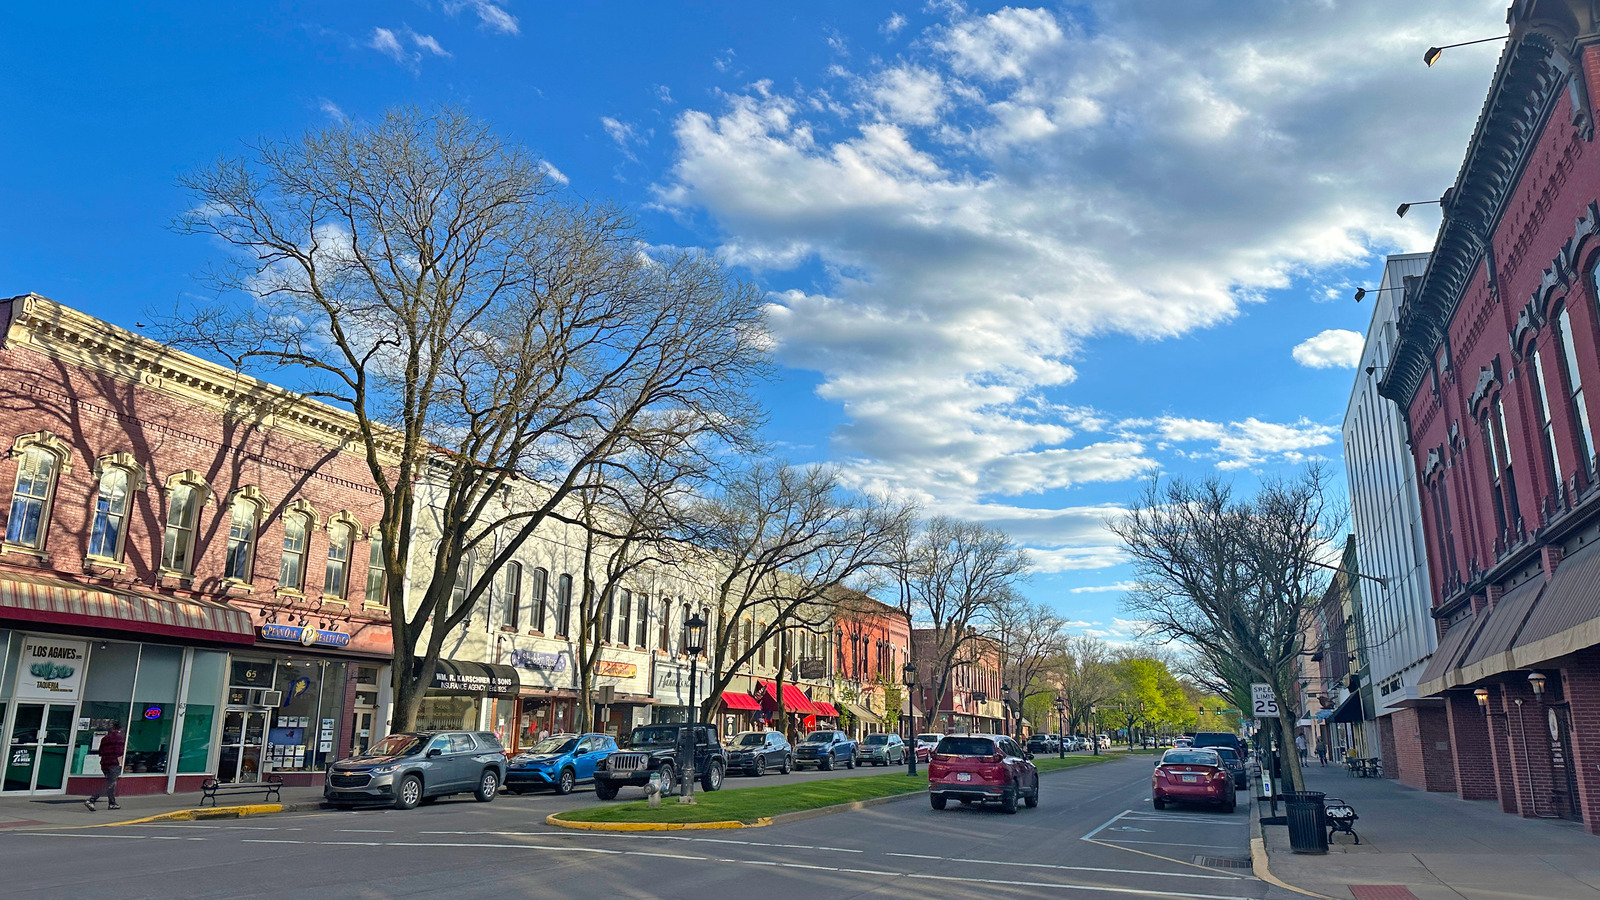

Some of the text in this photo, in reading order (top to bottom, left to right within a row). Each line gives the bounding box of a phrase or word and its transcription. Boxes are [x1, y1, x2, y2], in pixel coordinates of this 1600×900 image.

[267, 626, 299, 638] PENN OAK
[32, 645, 77, 660] LOS AGAVES
[246, 670, 257, 678] 65
[449, 674, 456, 682] R.
[457, 675, 490, 684] KARSCHNER
[497, 678, 512, 686] SONS
[440, 682, 468, 691] INSURANCE
[1255, 700, 1278, 712] 25
